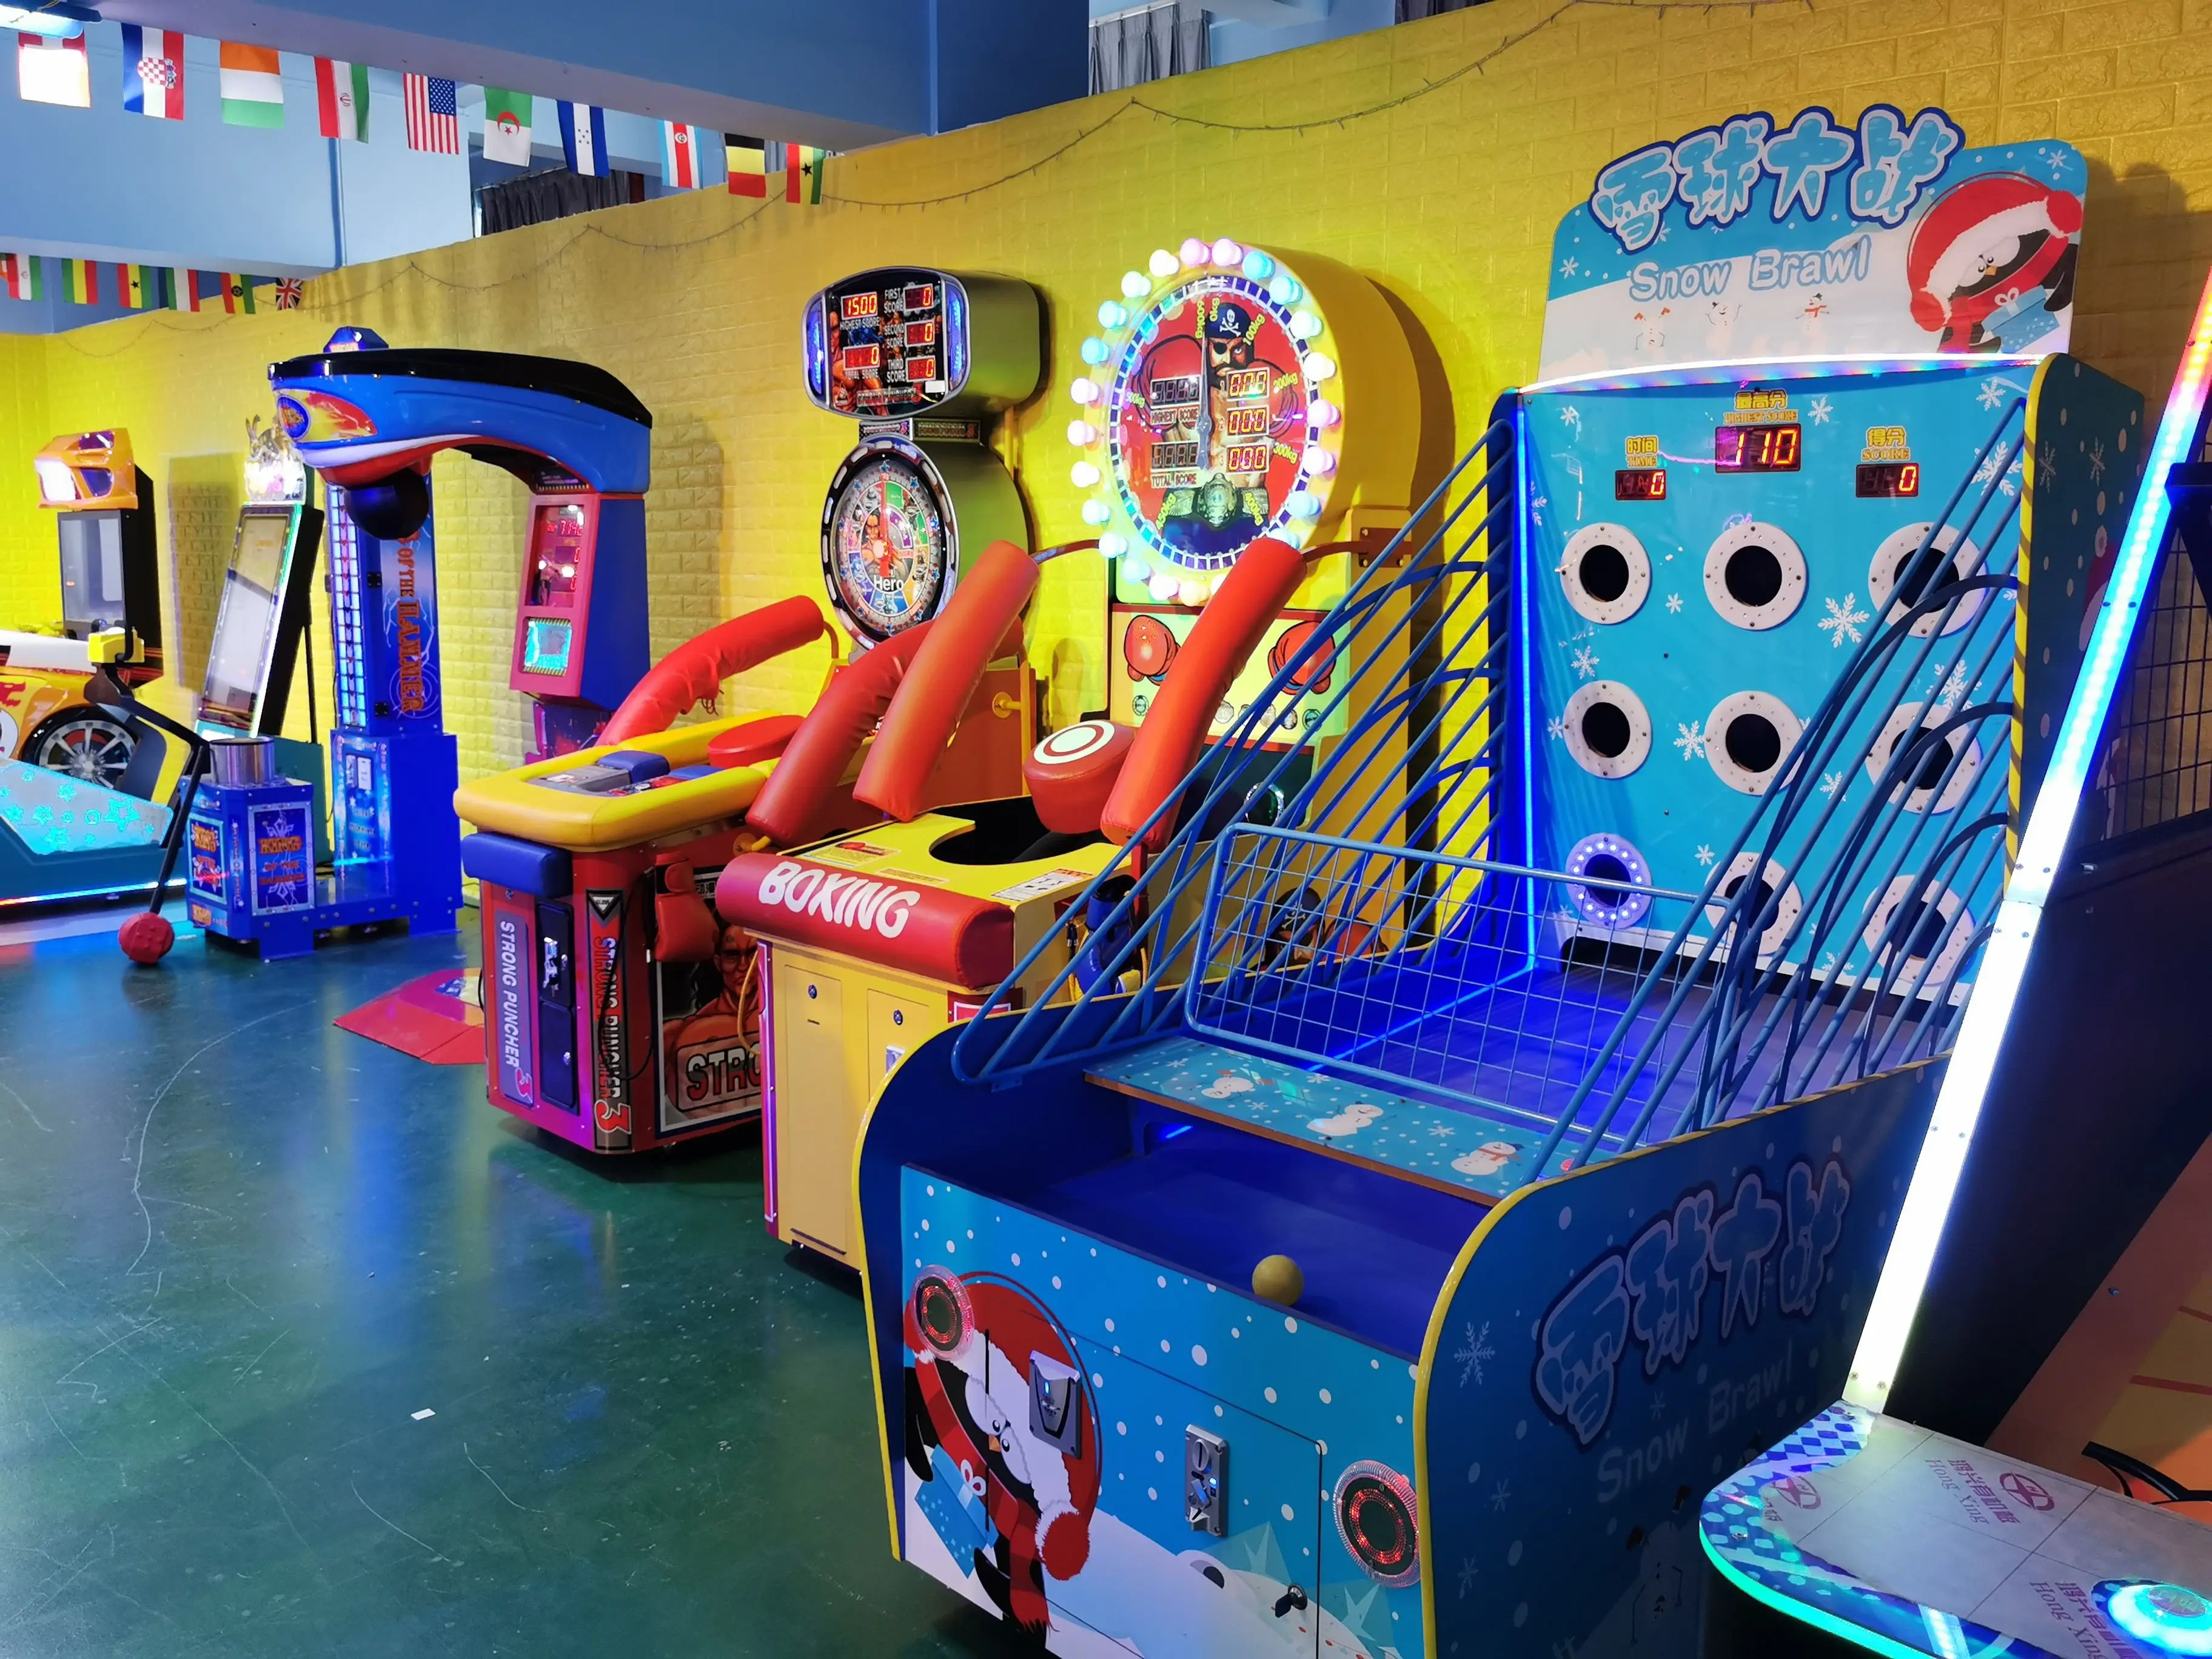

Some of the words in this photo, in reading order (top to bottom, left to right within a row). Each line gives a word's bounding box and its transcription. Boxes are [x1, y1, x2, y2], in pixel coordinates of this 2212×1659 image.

[1592, 105, 1962, 252] 雪球大战
[1629, 259, 1732, 303] Snow
[1749, 235, 1871, 290] Brawl
[885, 287, 901, 300] FIRST
[923, 287, 931, 306] 0
[848, 295, 877, 316] 1500
[883, 301, 903, 313] SCORE
[1210, 298, 1220, 321] 0kg
[840, 319, 861, 330] HIGHEST
[862, 317, 880, 328] SCORE
[885, 324, 905, 335] SECOND
[925, 323, 933, 342] 0
[1243, 313, 1265, 346] 100kg
[887, 337, 903, 349] SCORE
[871, 346, 879, 365] 0
[888, 358, 904, 370] THIRD
[845, 370, 860, 380] TOTAL
[862, 369, 879, 379] SCORE
[886, 370, 906, 383] SCORE
[926, 359, 934, 377] 0
[1273, 372, 1298, 394] 200kg
[1735, 389, 1788, 411] 最高分
[1151, 409, 1177, 425] HIGHEST
[1179, 407, 1199, 423] SCORE
[1228, 409, 1266, 434] 000
[1724, 412, 1765, 424] HIGHEST
[1766, 410, 1798, 423] SCORE
[1626, 436, 1658, 455] 时间
[1735, 429, 1797, 465] 110
[1865, 427, 1907, 447] 得分
[1273, 443, 1298, 464] 300kg
[1626, 455, 1657, 468] TIME
[1861, 447, 1911, 461] SCORE
[1151, 475, 1171, 488] TOTAL
[1175, 473, 1197, 486] SCORE
[1650, 472, 1664, 495] 0
[1899, 466, 1917, 492] 0
[1245, 492, 1264, 526] 400kg
[399, 570, 415, 597] THE
[874, 575, 904, 591] Hero
[398, 601, 425, 712] HAMMER
[759, 861, 920, 939] BOXING
[500, 921, 517, 985] STRONG
[594, 936, 621, 1010] STRONG
[502, 990, 520, 1068] PUNCHER
[597, 1014, 622, 1099] PUNCHER
[515, 1068, 533, 1103] 3
[594, 1099, 631, 1134] 3
[1535, 1160, 1851, 1447] 雪球大战
[1597, 1418, 1688, 1504] Snow
[1709, 1339, 1792, 1433] Brawl
[1925, 1458, 1960, 1491] Hong
[1954, 1493, 1990, 1524] Xing
[2029, 1581, 2074, 1621] Hong
